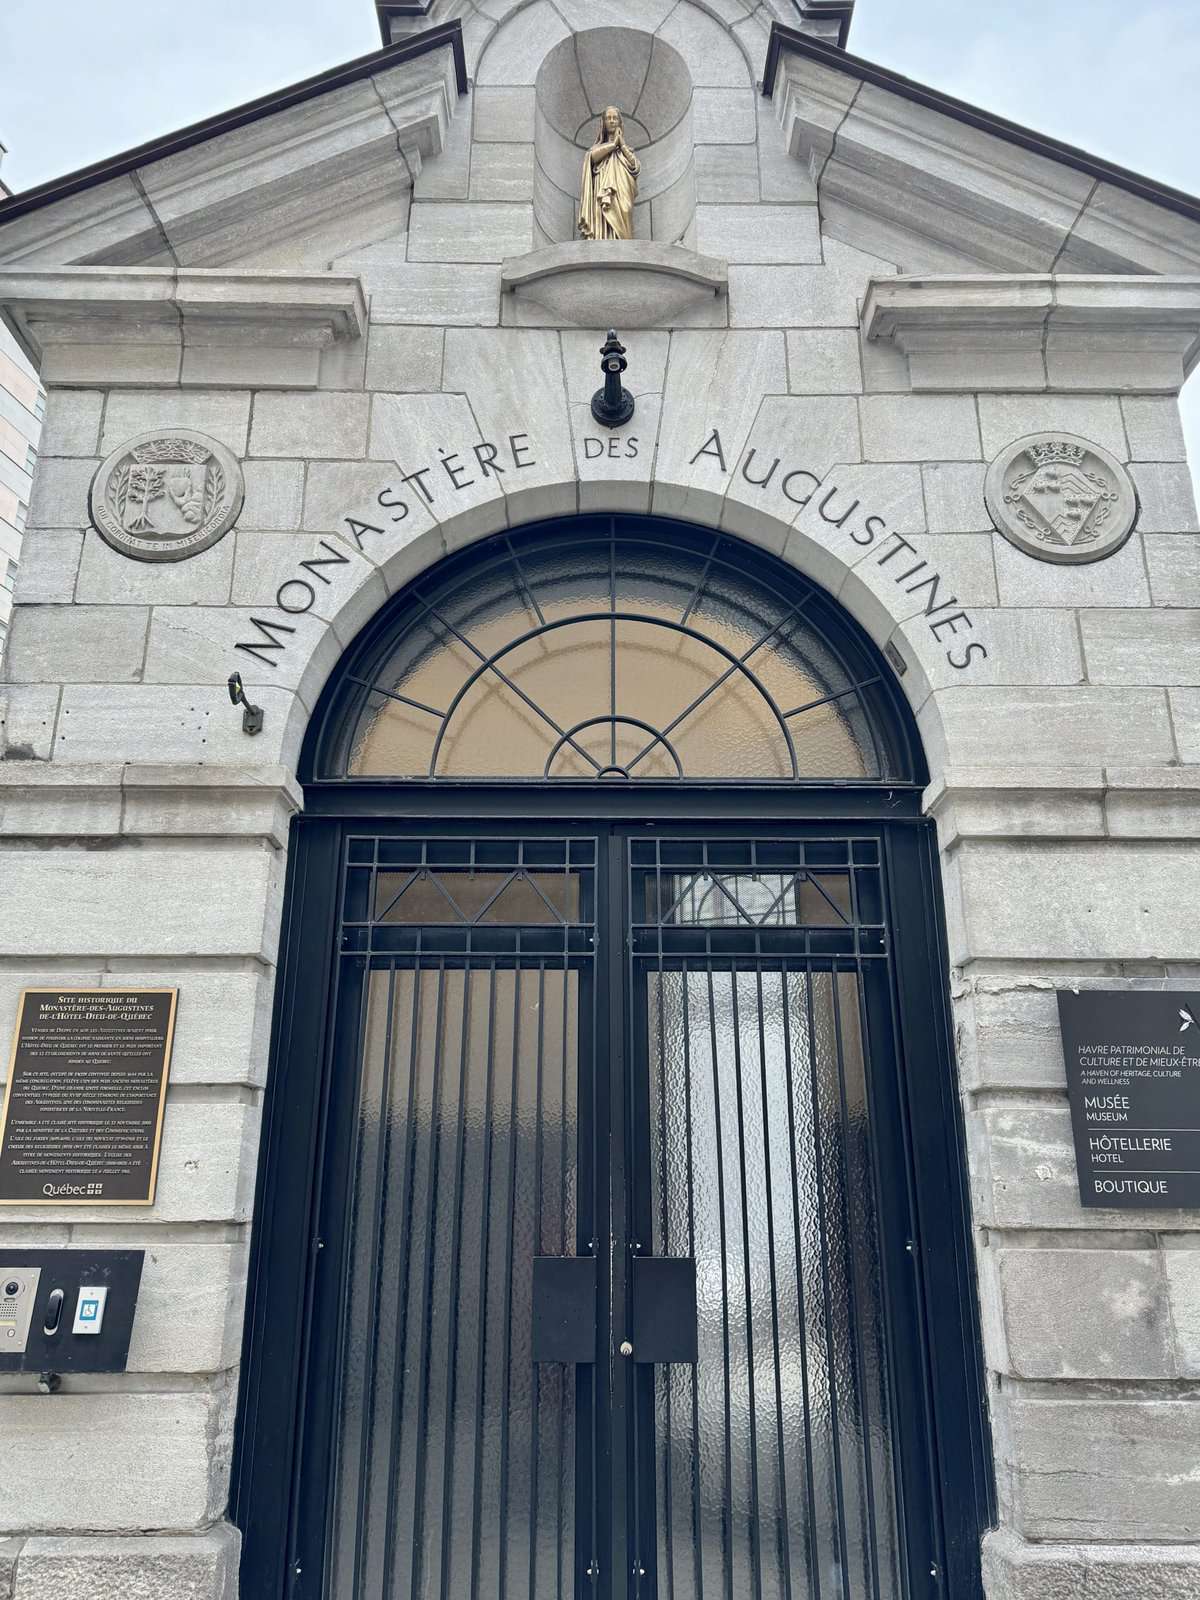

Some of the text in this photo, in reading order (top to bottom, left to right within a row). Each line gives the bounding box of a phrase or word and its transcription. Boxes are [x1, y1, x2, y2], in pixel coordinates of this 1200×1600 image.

[234, 428, 988, 670] MONASTÈRE DES AUGUSTINES
[78, 996, 124, 1004] HISTORIQUE
[1078, 1045, 1185, 1055] HAVRE PATRIMONIAL DE
[1080, 1057, 1122, 1066] CULTURE
[1122, 1058, 1134, 1066] ET
[1136, 1058, 1148, 1066] DE
[1084, 1094, 1130, 1109] MUSÉE
[1086, 1112, 1128, 1121] MUSEUM
[1089, 1135, 1172, 1151] HÔTELLERIE
[1091, 1154, 1124, 1163] HOTEL
[42, 1183, 86, 1196] Québec
[1094, 1180, 1168, 1194] BOUTIQUE
